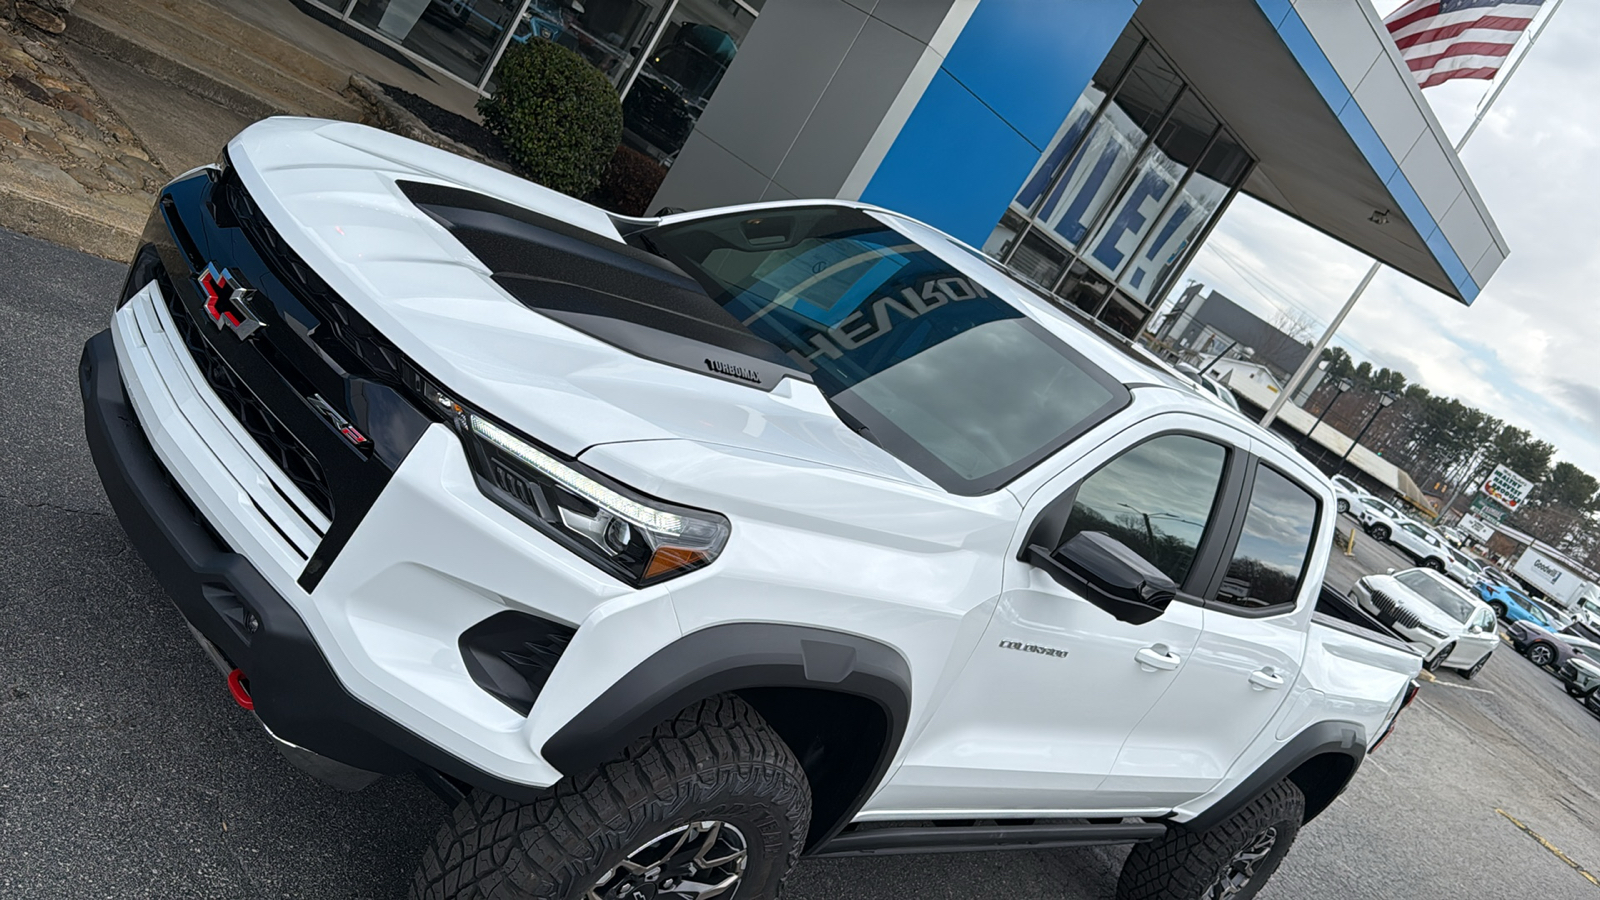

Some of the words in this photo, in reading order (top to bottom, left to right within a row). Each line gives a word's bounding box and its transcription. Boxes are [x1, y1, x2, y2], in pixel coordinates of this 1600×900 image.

[704, 359, 761, 383] TURBOMAX
[1493, 477, 1522, 496] HARVEST
[1494, 470, 1522, 489] HEALTHY
[1492, 483, 1521, 504] PRODUCE
[1534, 559, 1558, 578] Goodwill
[999, 640, 1069, 658] COLORADO
